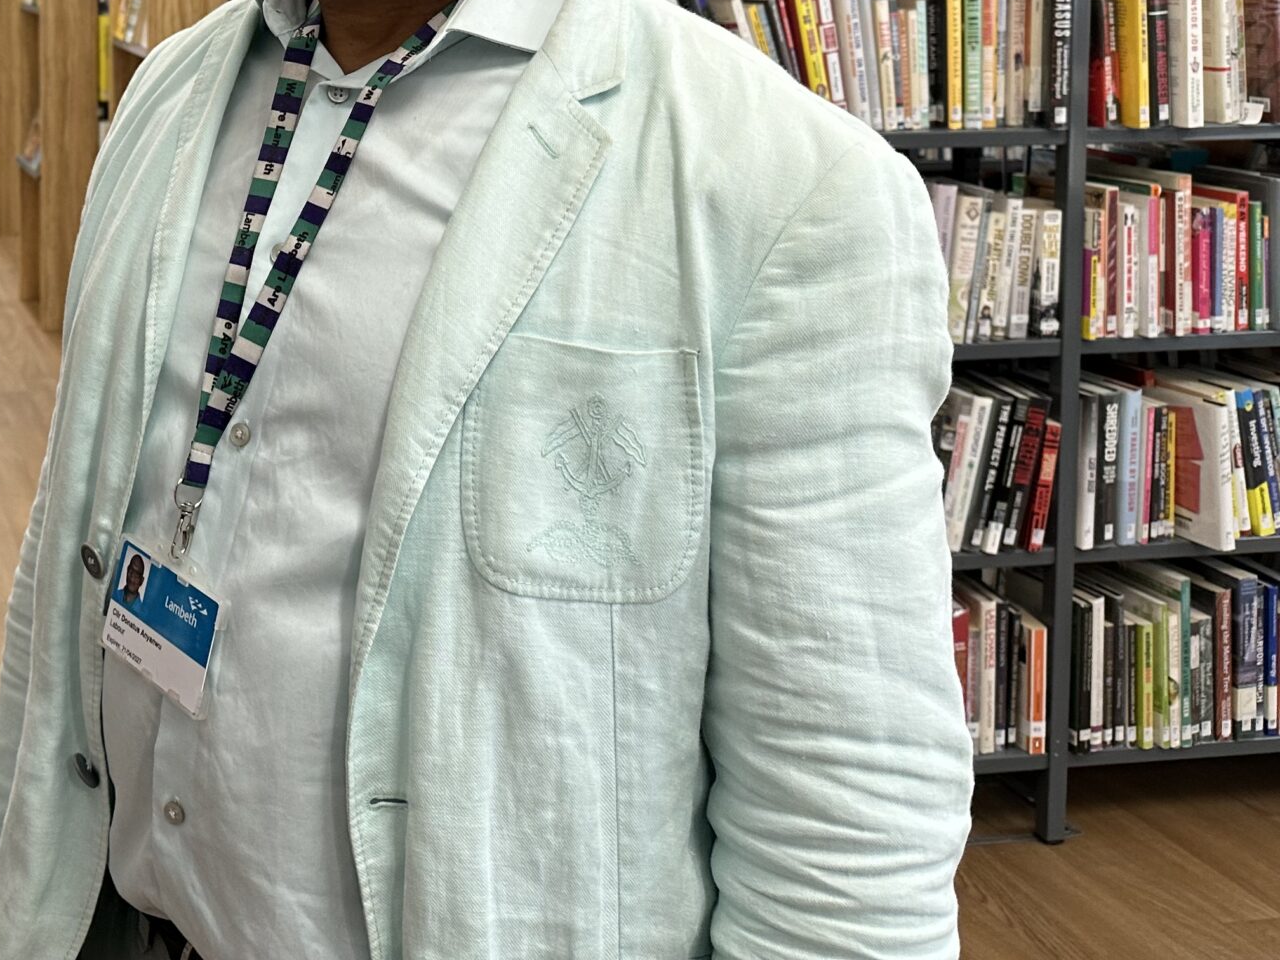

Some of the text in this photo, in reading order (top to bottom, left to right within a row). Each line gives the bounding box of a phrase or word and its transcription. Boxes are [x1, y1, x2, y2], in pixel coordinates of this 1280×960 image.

[1155, 18, 1169, 104] KURT ANDERSEN
[1190, 33, 1198, 52] JOB
[1018, 214, 1034, 288] DOUBLE DOWN
[1238, 221, 1247, 272] WEEKEND
[267, 284, 282, 308] Are
[219, 331, 233, 355] Are
[998, 403, 1010, 422] THE
[1104, 402, 1119, 462] SHREDDED
[989, 424, 1006, 467] PERFECT
[1247, 418, 1262, 468] Investing
[165, 595, 197, 628] Lambeth
